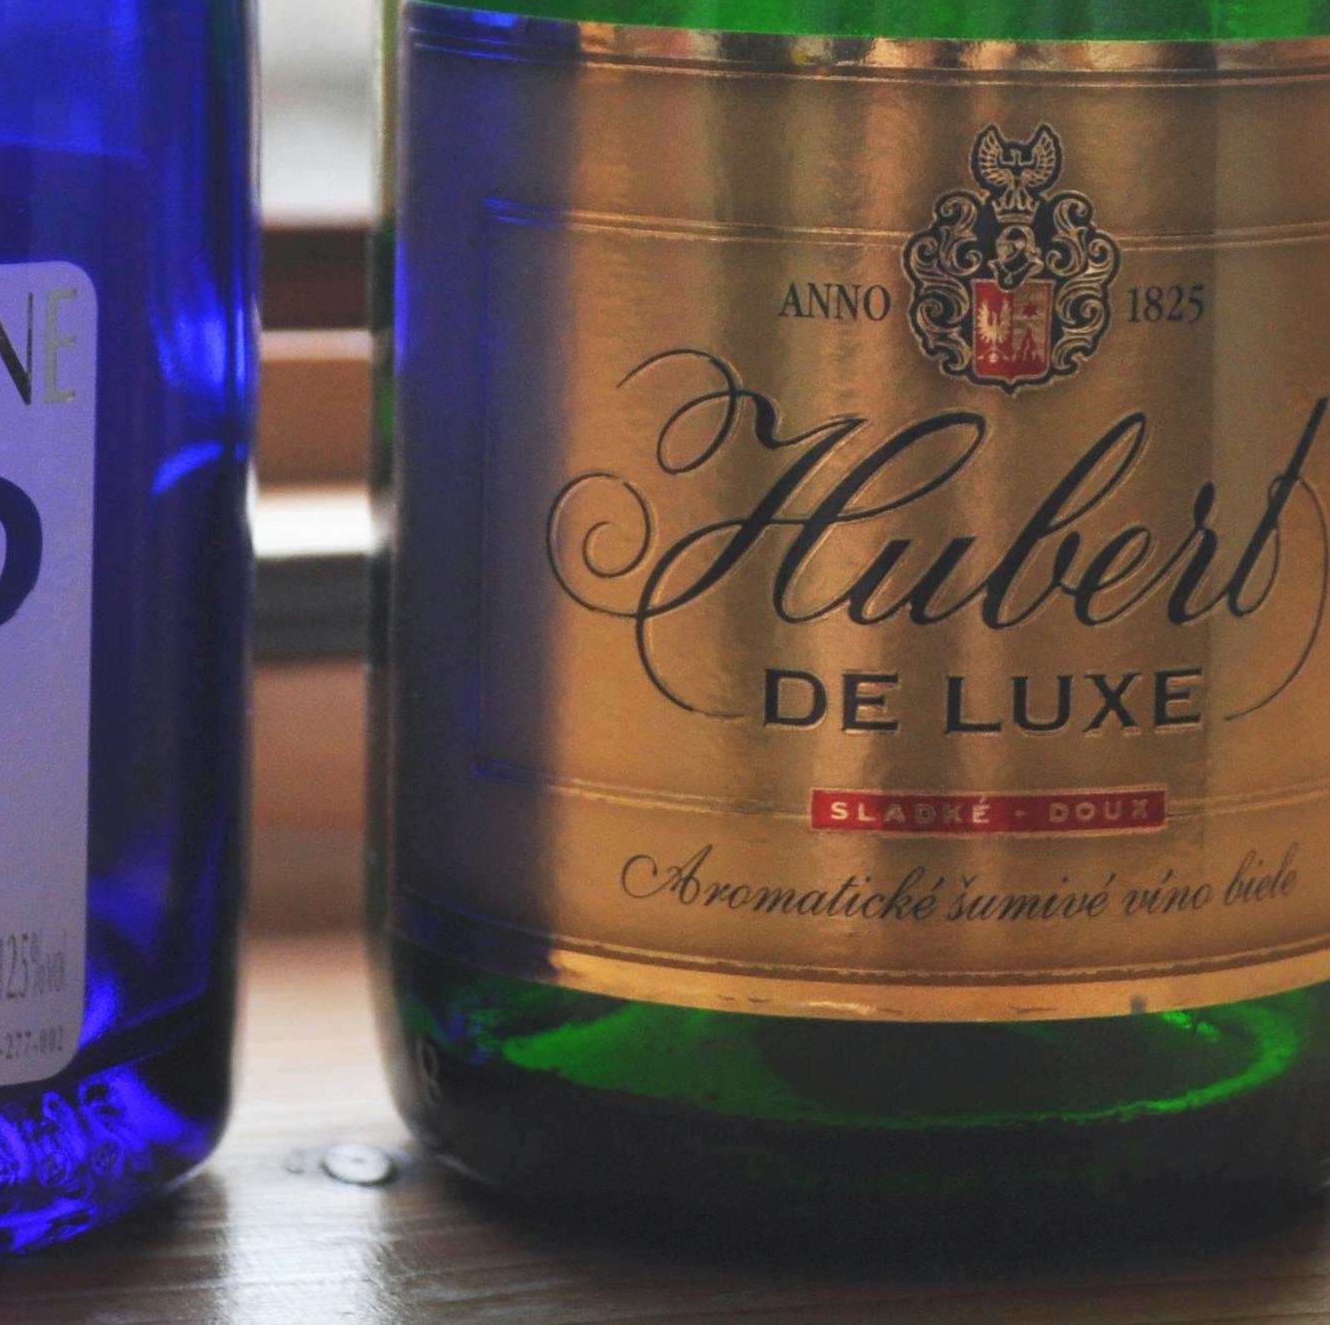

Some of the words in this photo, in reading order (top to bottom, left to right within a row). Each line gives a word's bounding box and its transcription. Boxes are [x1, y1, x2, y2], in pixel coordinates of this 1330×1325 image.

[778, 282, 891, 322] ANNO
[1127, 284, 1206, 324] 1825
[547, 349, 1329, 639] Hubert
[764, 667, 901, 732] DE
[945, 667, 1203, 735] LUXE
[830, 794, 991, 824] SLADKÉ
[1049, 798, 1150, 824] DOUX
[620, 843, 946, 921] Aromatické
[947, 872, 1117, 922] šumivé
[1122, 868, 1215, 916] víno
[1223, 842, 1300, 907] biele
